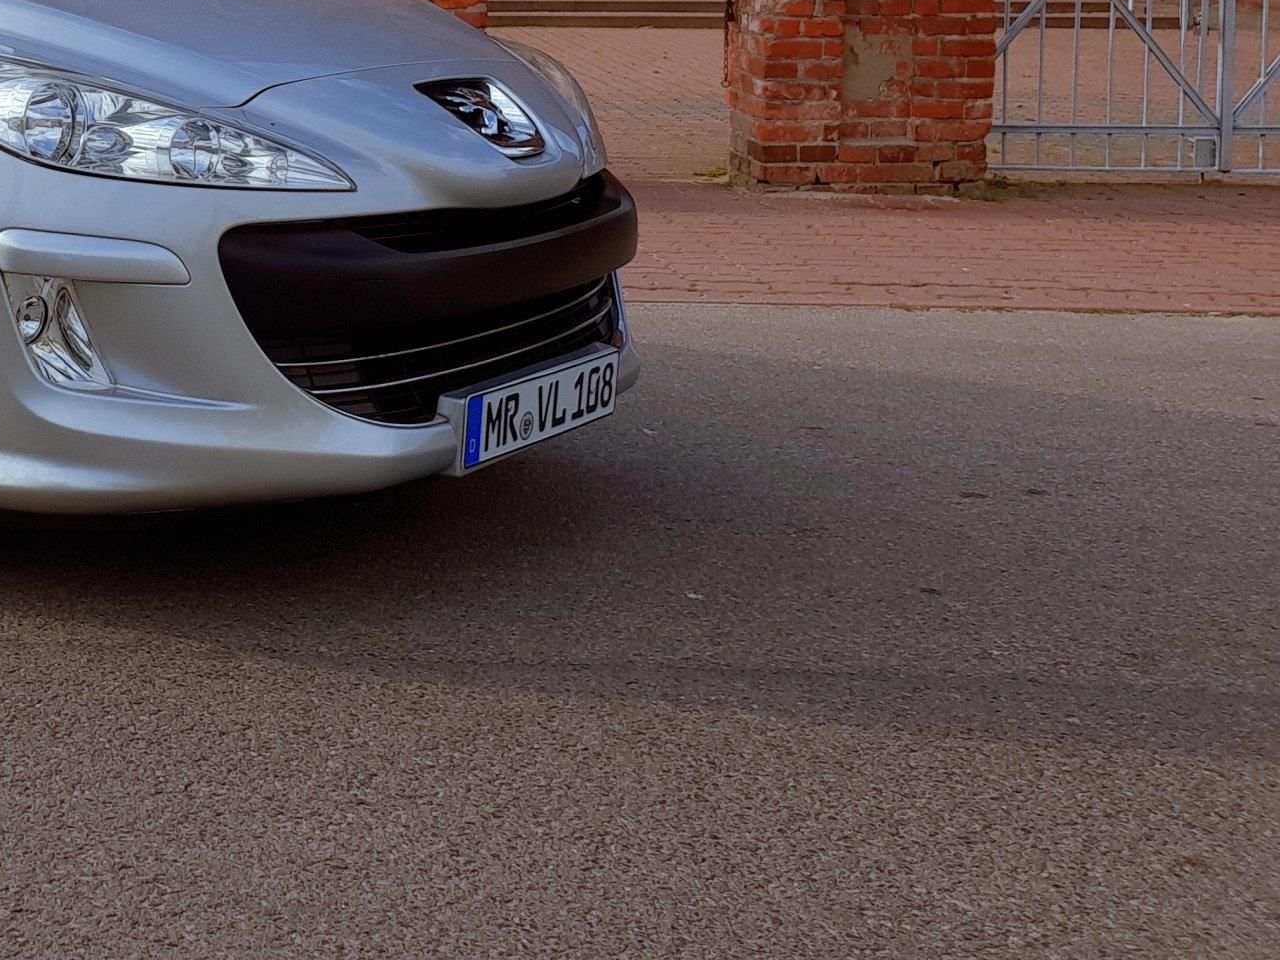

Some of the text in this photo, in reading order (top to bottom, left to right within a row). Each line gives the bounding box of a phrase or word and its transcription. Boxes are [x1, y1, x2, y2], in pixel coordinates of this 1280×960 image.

[484, 362, 614, 452] MR VL 108
[469, 438, 476, 453] D
